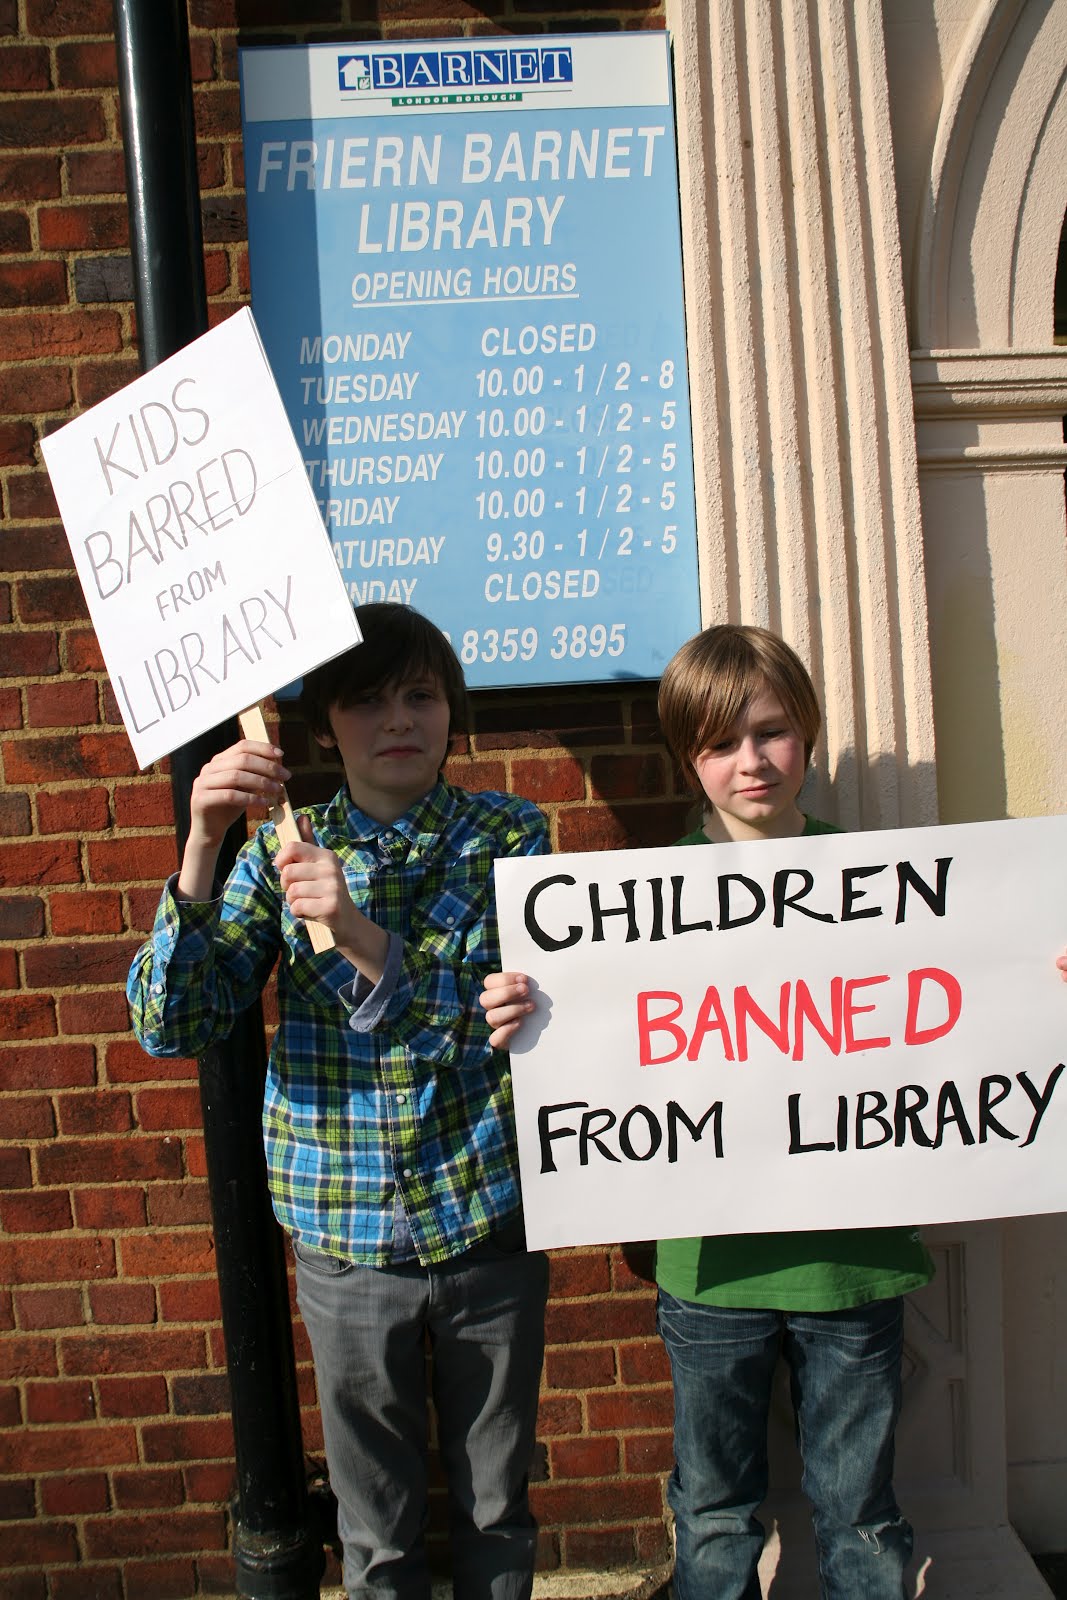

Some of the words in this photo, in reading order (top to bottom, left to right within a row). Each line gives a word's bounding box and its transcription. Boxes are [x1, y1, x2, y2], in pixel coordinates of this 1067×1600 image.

[374, 50, 571, 86] BARNET
[399, 96, 449, 105] LONDON
[456, 93, 517, 102] BOROUGH
[257, 134, 441, 193] FRIERN
[461, 126, 665, 184] BARNET
[357, 195, 565, 254] LIBRARY
[351, 267, 471, 301] OPENING
[483, 263, 577, 295] HOURS
[300, 331, 411, 365] MONDAY
[481, 323, 596, 357] CLOSED
[301, 371, 419, 405] TUESDAY
[476, 365, 543, 398] 10.00
[93, 377, 210, 496] KIDS
[303, 410, 466, 446] WEDNESDAY
[476, 406, 546, 439] 10.00
[305, 453, 444, 488] THURSDAY
[475, 447, 546, 480] 10.00
[83, 448, 258, 601] BARRED
[475, 487, 545, 520] 10.00
[332, 536, 446, 570] ATURDAY
[486, 530, 545, 563] 9.30
[156, 560, 227, 622] FROM
[344, 578, 418, 606] NDAY
[484, 569, 600, 603] CLOSED
[117, 575, 298, 735] LIBRARY
[460, 627, 538, 665] 8359
[551, 623, 627, 660] 3895
[523, 857, 954, 953] CHILDREN
[636, 967, 963, 1067] BANNED
[537, 1100, 725, 1175] FROM
[787, 1063, 1066, 1156] LIBRARY
